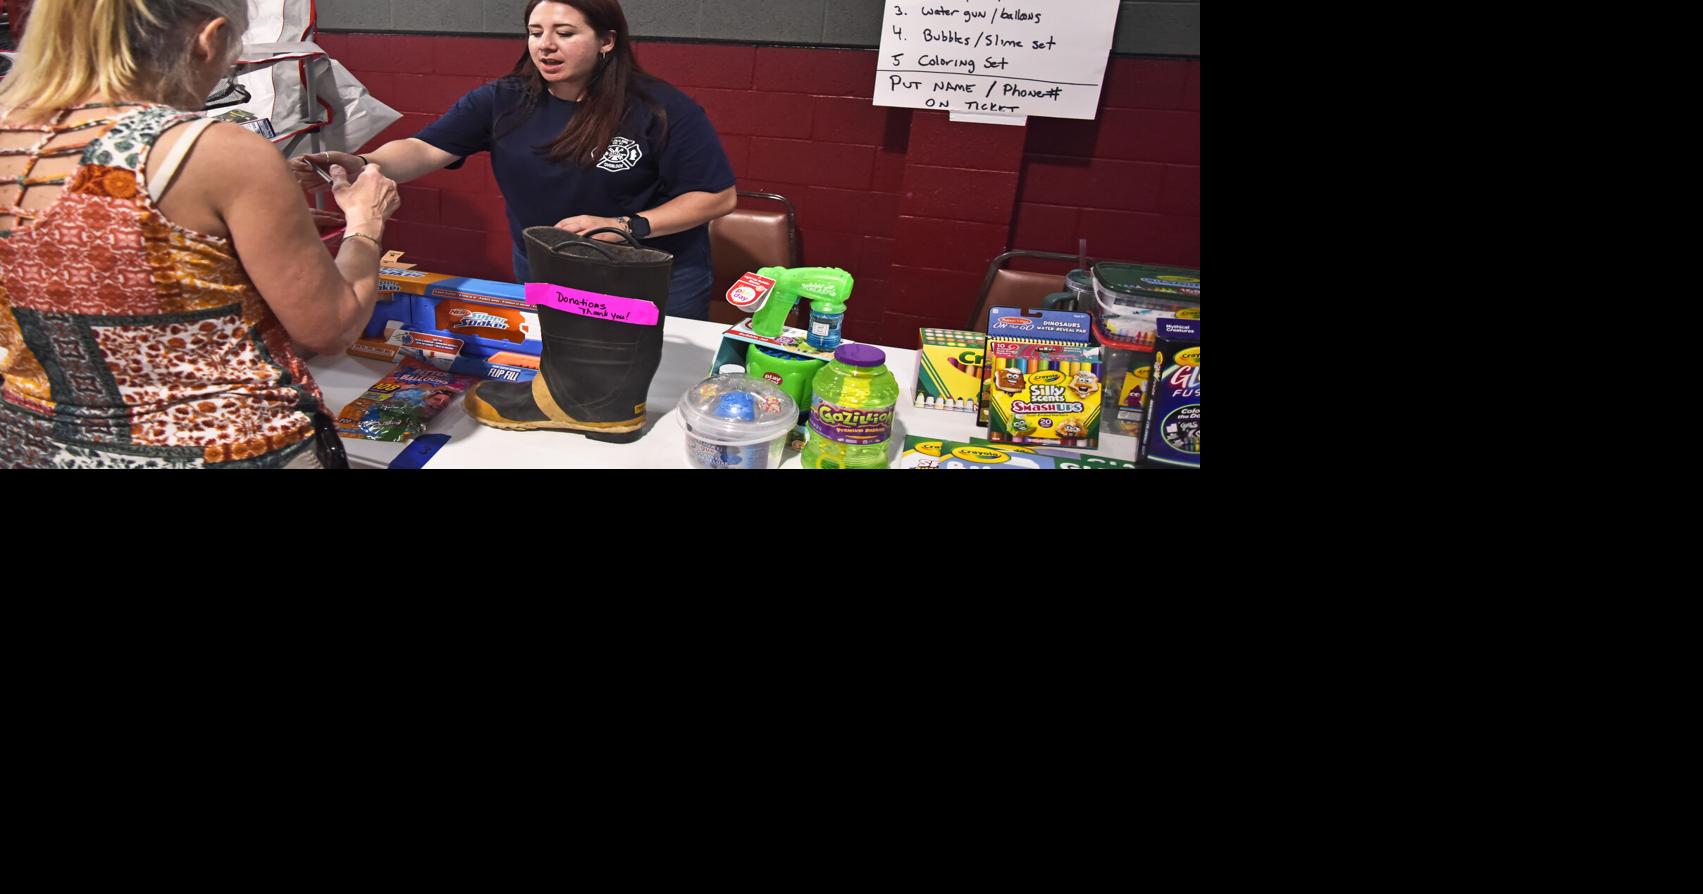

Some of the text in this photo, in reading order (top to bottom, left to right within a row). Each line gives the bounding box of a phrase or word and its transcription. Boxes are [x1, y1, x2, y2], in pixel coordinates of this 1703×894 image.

[895, 6, 907, 16] 3.
[893, 25, 907, 41] 4.
[933, 82, 976, 93] NAME
[925, 98, 949, 108] ON
[556, 291, 607, 310] Donations
[578, 306, 609, 317] Thank
[1043, 320, 1081, 328] DINOSAURS
[1166, 323, 1191, 331] Mythical
[487, 368, 505, 378] FLIP
[503, 370, 519, 381] FILL
[1170, 365, 1200, 389] GL
[1030, 384, 1065, 397] Silly
[1172, 388, 1200, 398] FUS
[958, 448, 1001, 458] Crayola
